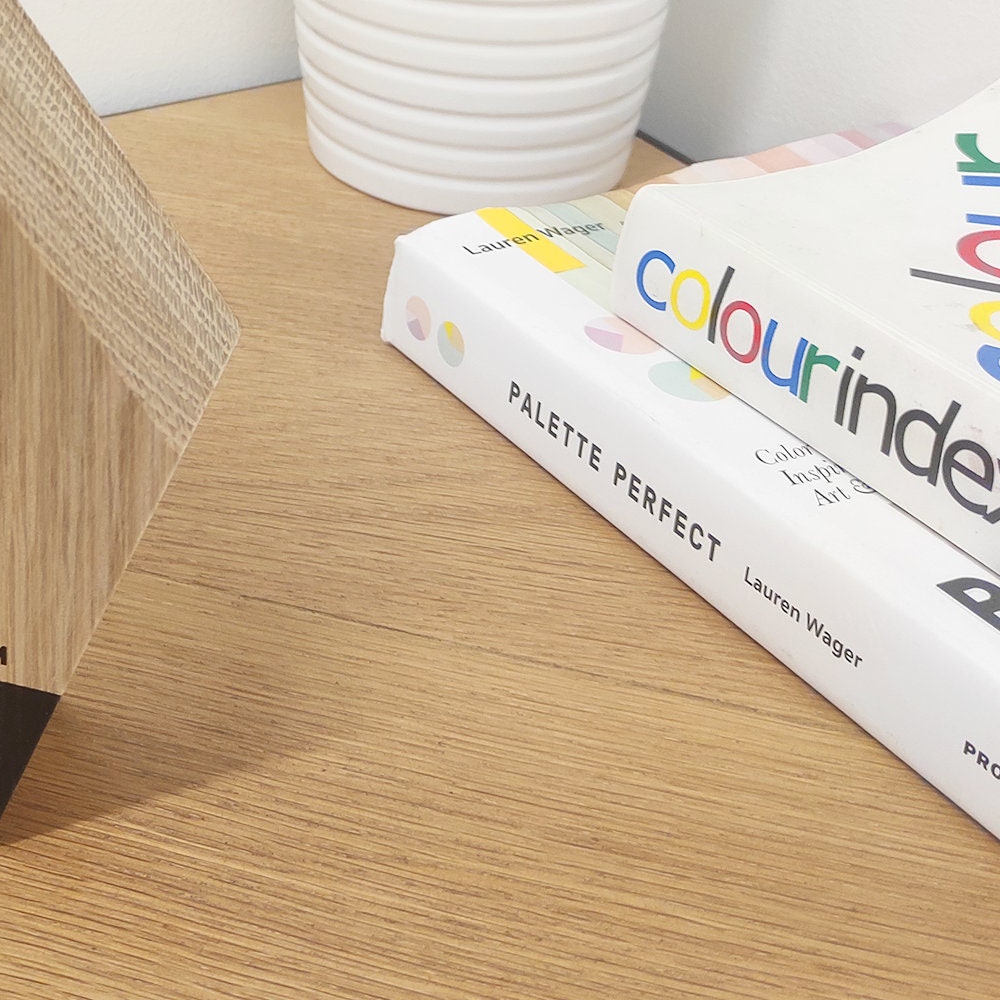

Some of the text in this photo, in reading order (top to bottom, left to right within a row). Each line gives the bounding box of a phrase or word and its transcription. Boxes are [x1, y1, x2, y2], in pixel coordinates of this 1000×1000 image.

[463, 231, 540, 256] Lauren
[536, 211, 606, 238] Wager
[636, 249, 1000, 524] colourinde
[508, 380, 722, 563] PALETTE PERFECT
[813, 486, 851, 507] Art
[743, 566, 864, 669] Lauren Wager
